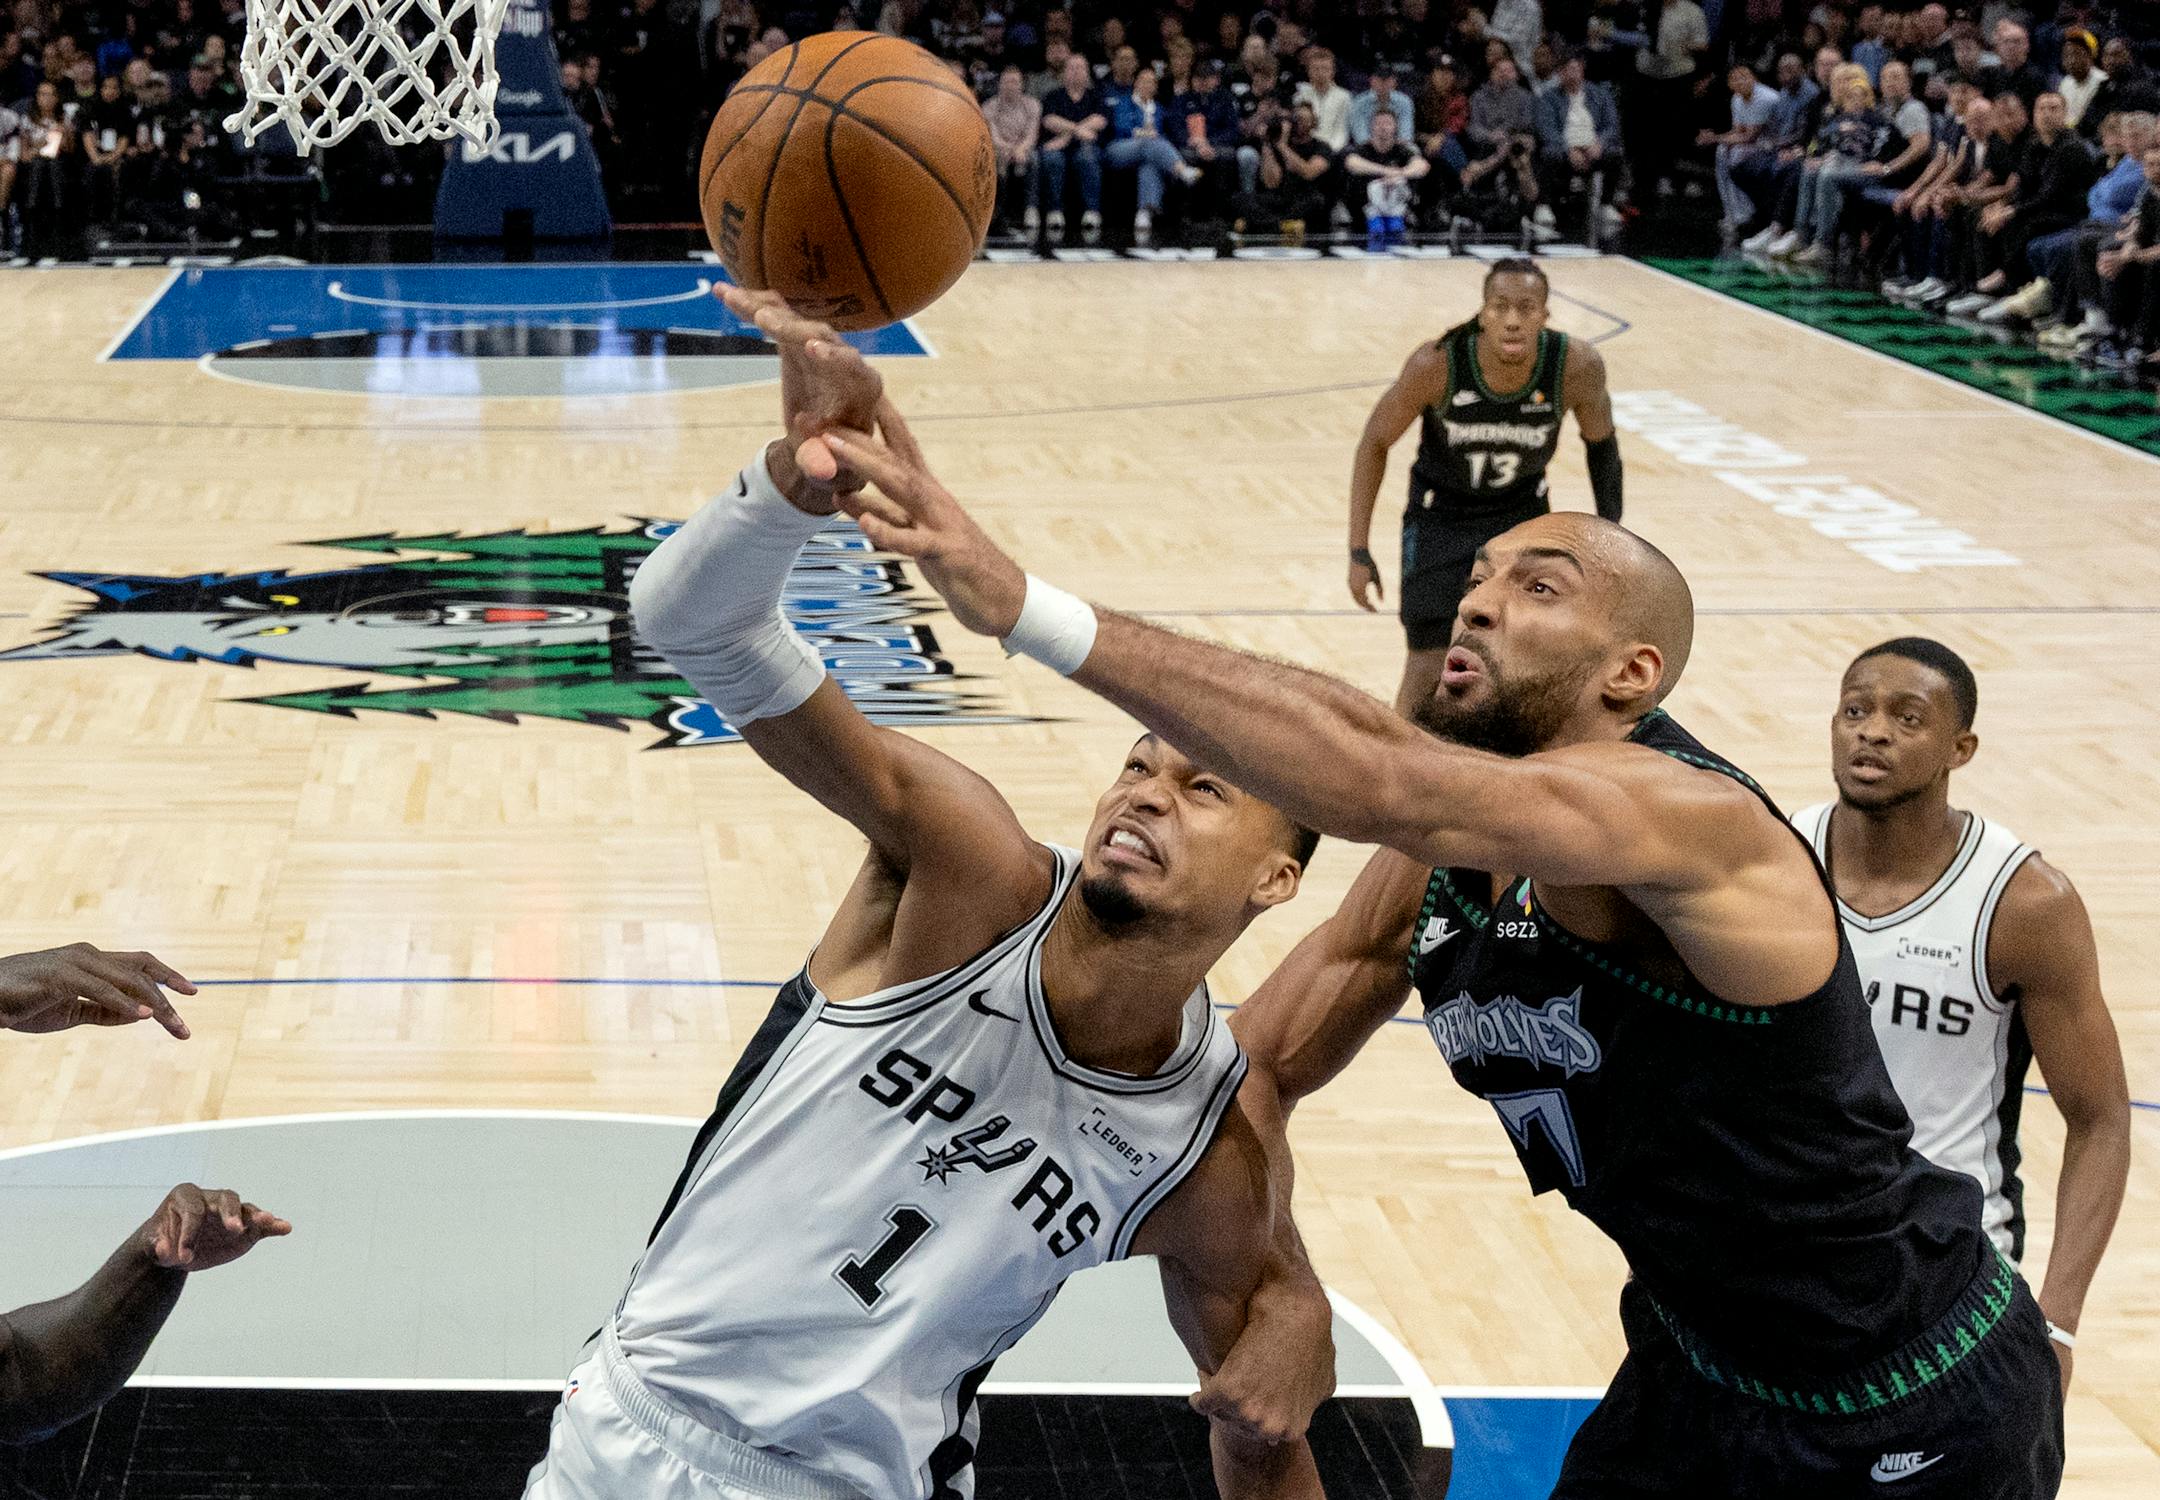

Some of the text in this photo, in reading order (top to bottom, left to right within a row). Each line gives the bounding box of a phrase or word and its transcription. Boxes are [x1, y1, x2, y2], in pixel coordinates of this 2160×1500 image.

[1464, 450, 1522, 489] 13
[1426, 916, 1452, 941] NIKE
[1904, 944, 1953, 960] LEDGER
[1424, 985, 1601, 1079] BERWOLVES
[1091, 1119, 1145, 1167] LEDGER
[831, 1203, 940, 1317] 1
[1880, 1450, 1924, 1471] NIKE
